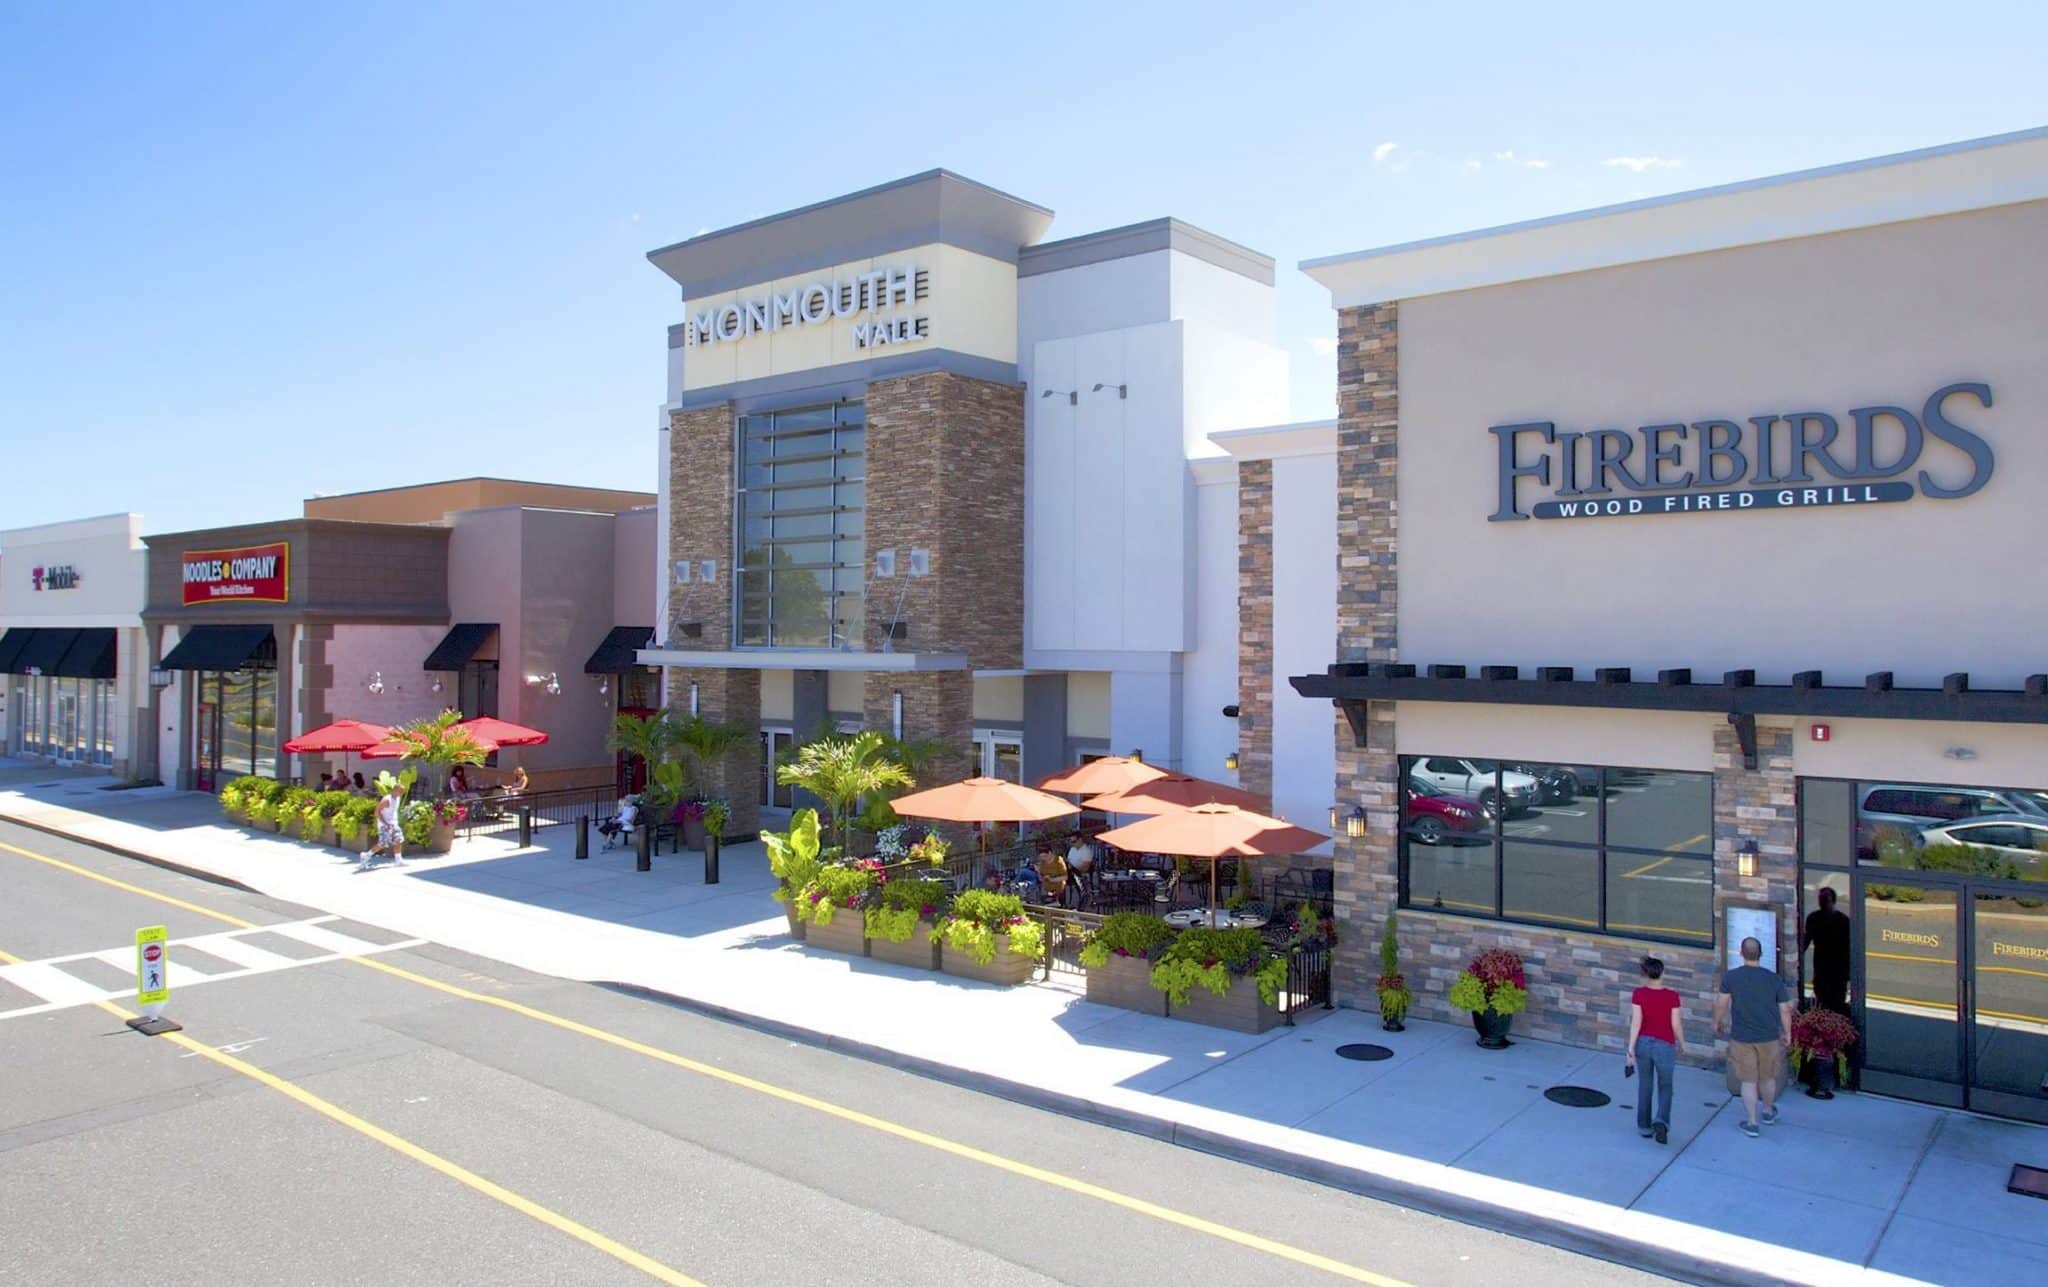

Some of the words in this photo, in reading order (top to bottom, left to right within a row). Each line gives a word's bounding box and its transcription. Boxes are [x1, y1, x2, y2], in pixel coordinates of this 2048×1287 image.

[690, 264, 918, 348] MONMOUTH
[852, 317, 924, 350] MALL
[1488, 382, 1995, 522] FIREBIRDS
[1559, 500, 1644, 518] WOOD
[1664, 493, 1755, 511] FIRED
[1777, 485, 1880, 506] GRILL
[183, 561, 222, 583] NOODLES
[231, 556, 276, 580] COMPANY
[1882, 929, 1939, 947] FIREBIRDS
